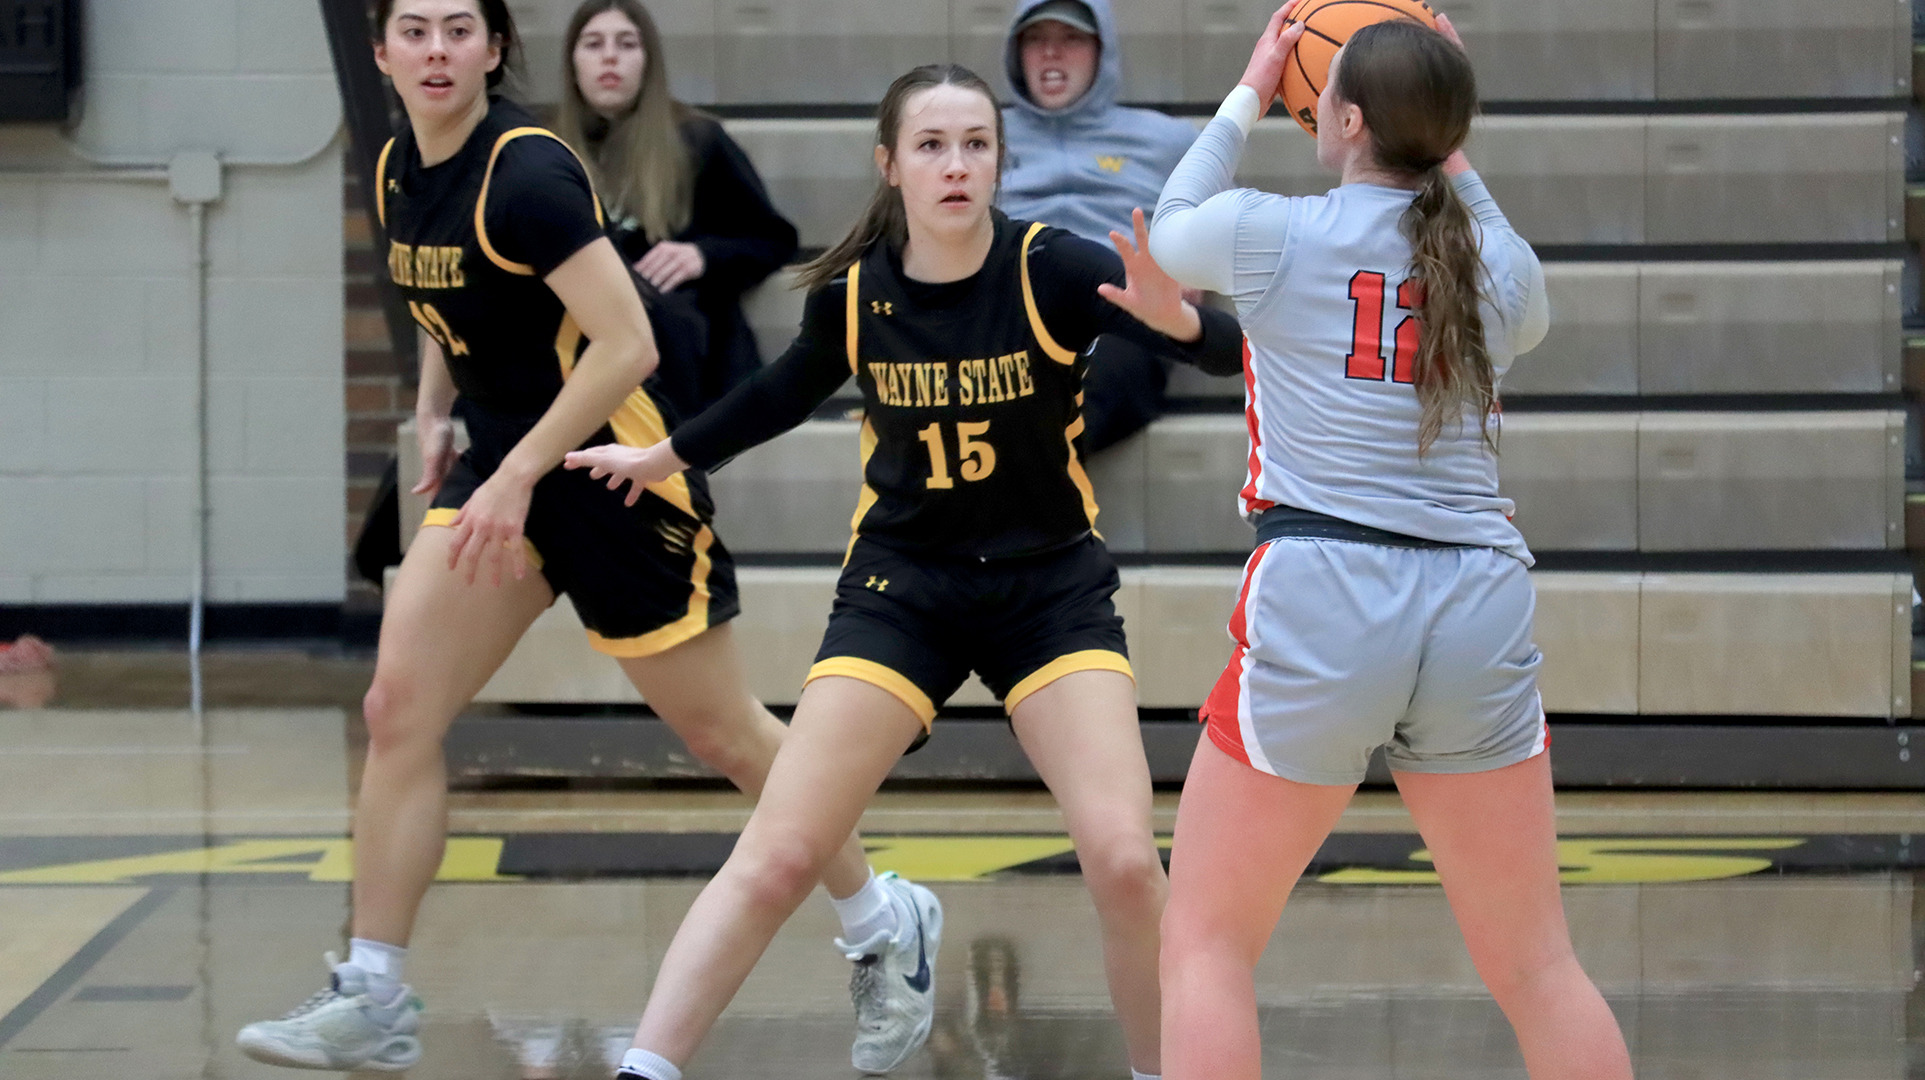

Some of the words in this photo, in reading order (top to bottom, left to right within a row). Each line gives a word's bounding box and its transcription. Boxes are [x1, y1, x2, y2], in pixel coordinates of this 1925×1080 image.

[415, 245, 465, 288] STATE
[868, 362, 949, 407] WAYNE
[958, 350, 1035, 406] STATE
[918, 419, 996, 489] 15
